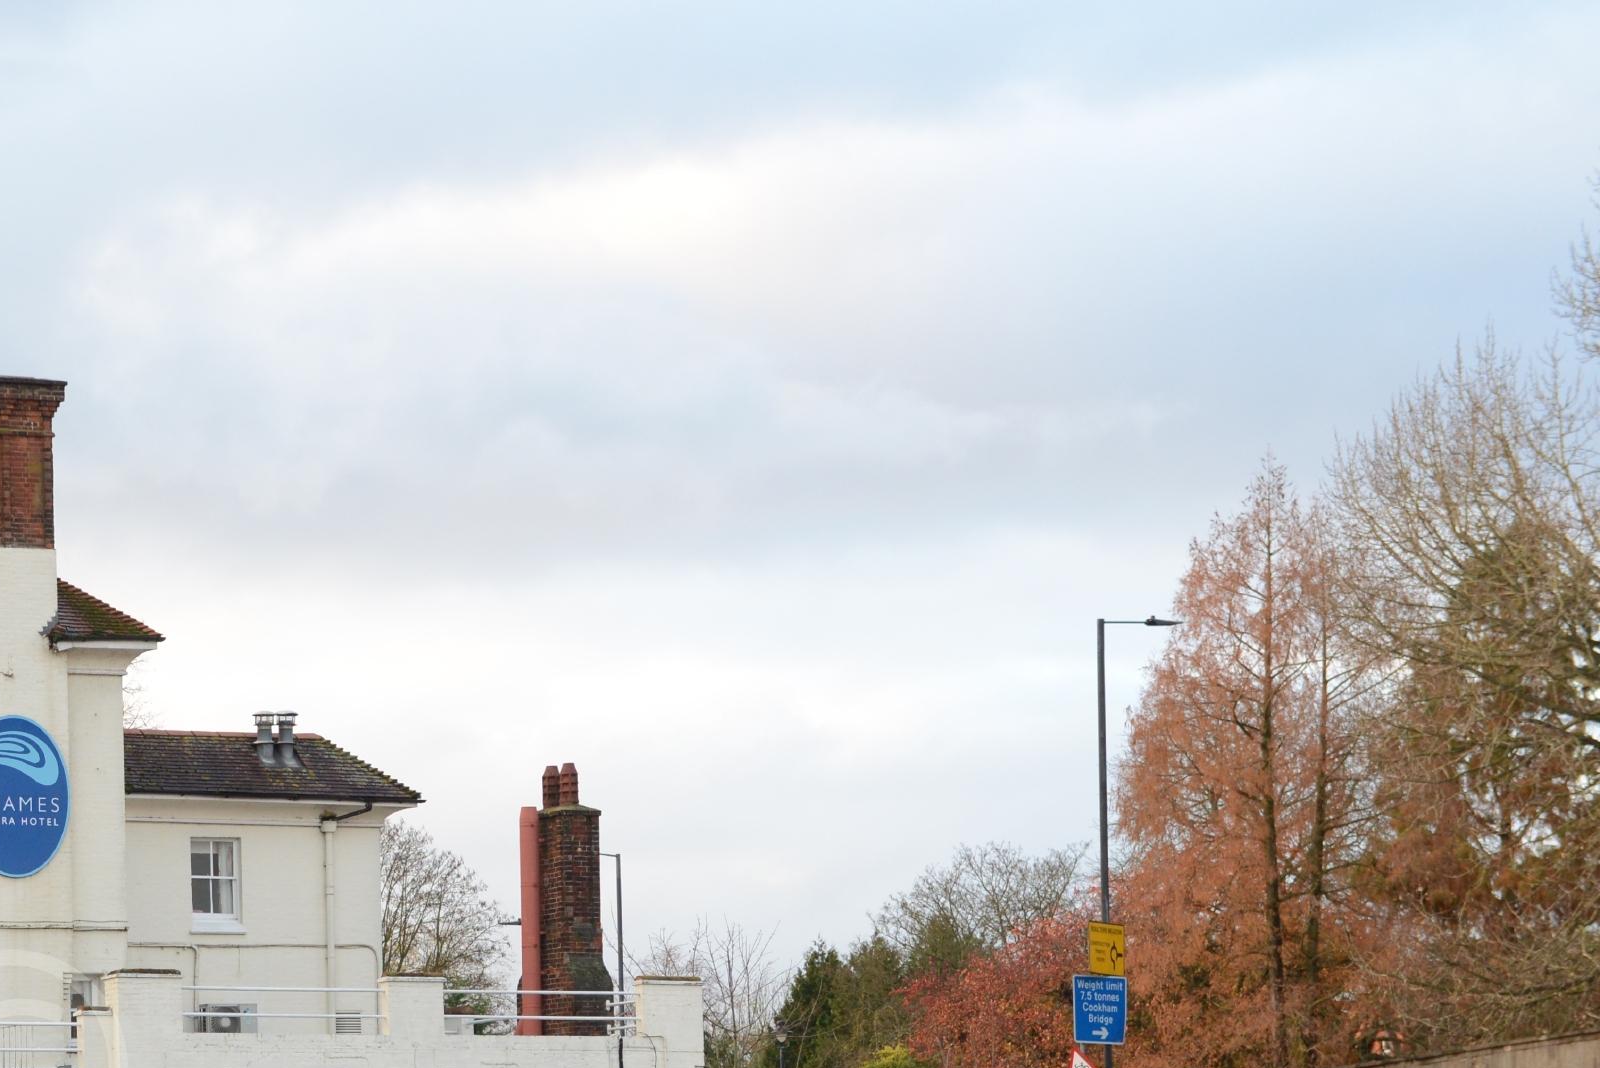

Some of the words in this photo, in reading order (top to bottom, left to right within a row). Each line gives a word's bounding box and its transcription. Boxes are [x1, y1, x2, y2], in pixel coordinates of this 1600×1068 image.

[21, 817, 59, 827] HOTEL
[1077, 979, 1104, 992] Weight
[1106, 981, 1123, 991] limit
[1080, 991, 1092, 1001] 7.5
[1094, 991, 1120, 1002] tonnes
[1082, 1002, 1118, 1013] Cookham
[1088, 1013, 1113, 1026] Bridge
